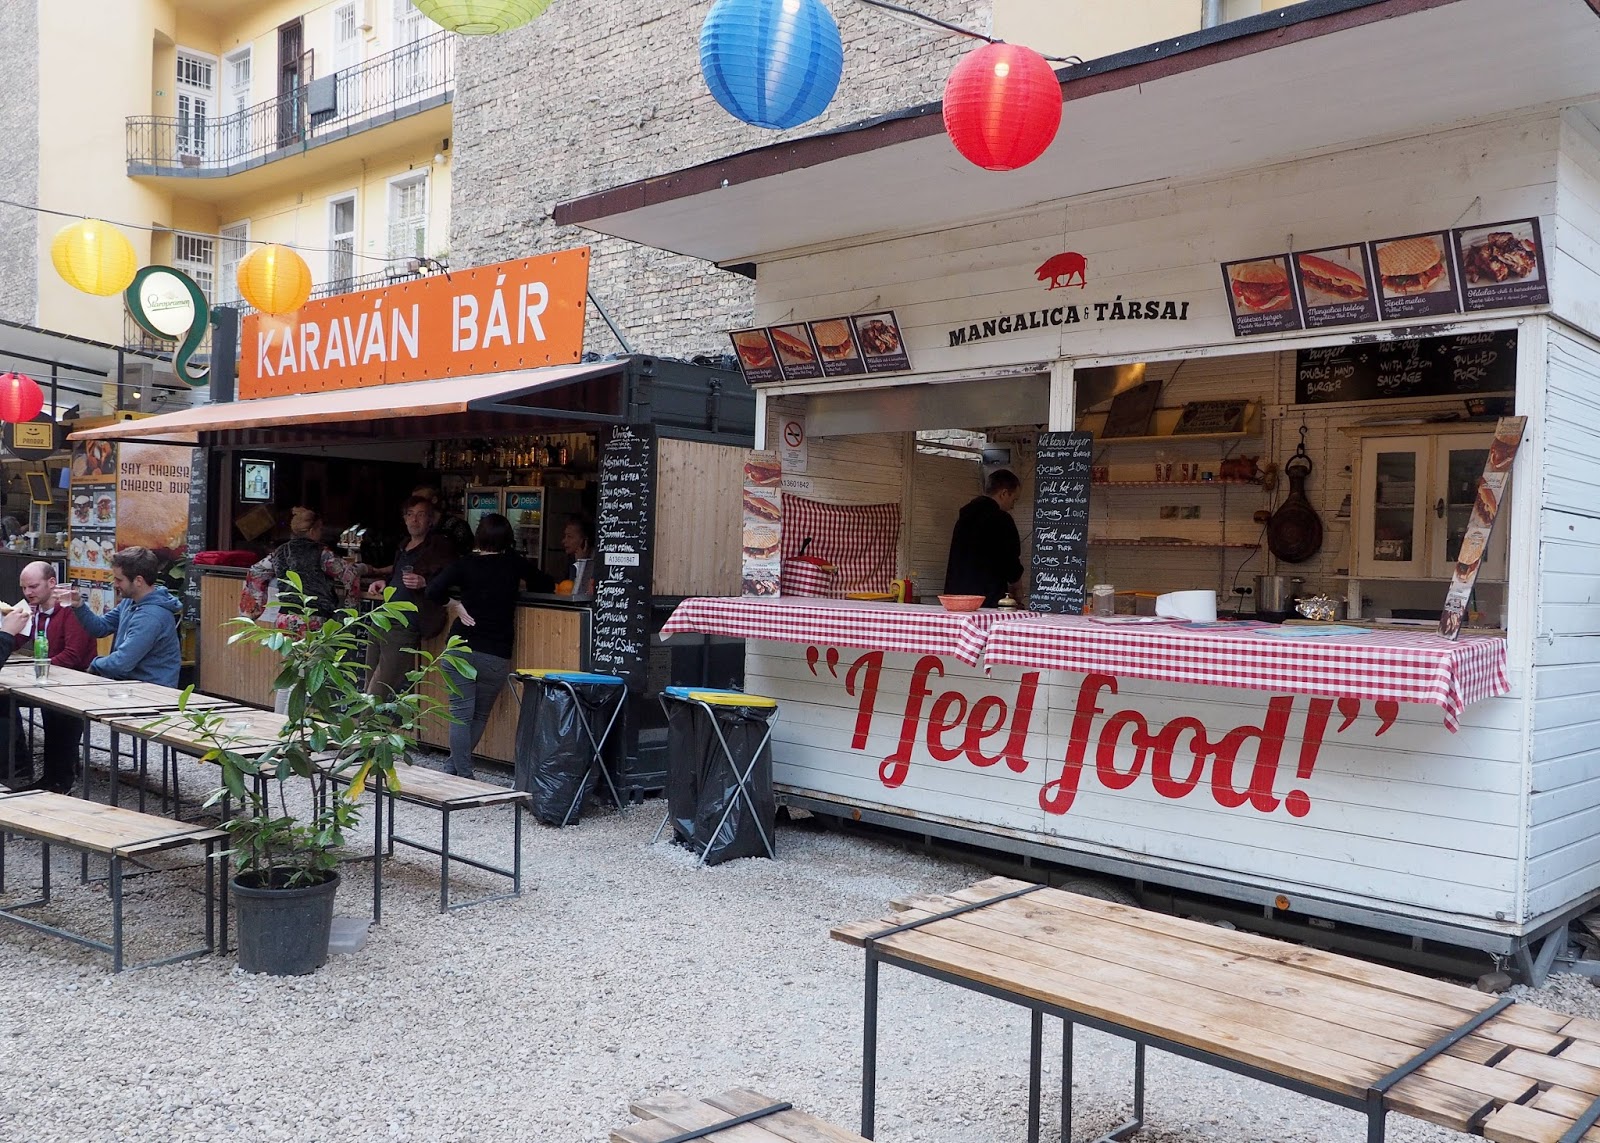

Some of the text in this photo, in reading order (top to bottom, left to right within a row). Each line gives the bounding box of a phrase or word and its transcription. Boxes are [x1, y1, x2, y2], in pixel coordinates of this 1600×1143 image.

[257, 274, 549, 379] KARAVÁN BÁR
[948, 295, 1190, 347] MANGALICA & TÁRSAI
[1380, 360, 1403, 371] WITH
[1453, 350, 1498, 367] PULLED
[1300, 365, 1355, 380] DOUBLE HAND
[1377, 371, 1422, 388] SAUSAGE
[1453, 367, 1488, 381] PORK
[1307, 379, 1342, 395] BURGER
[121, 462, 142, 475] SAY
[878, 654, 1041, 789] feel
